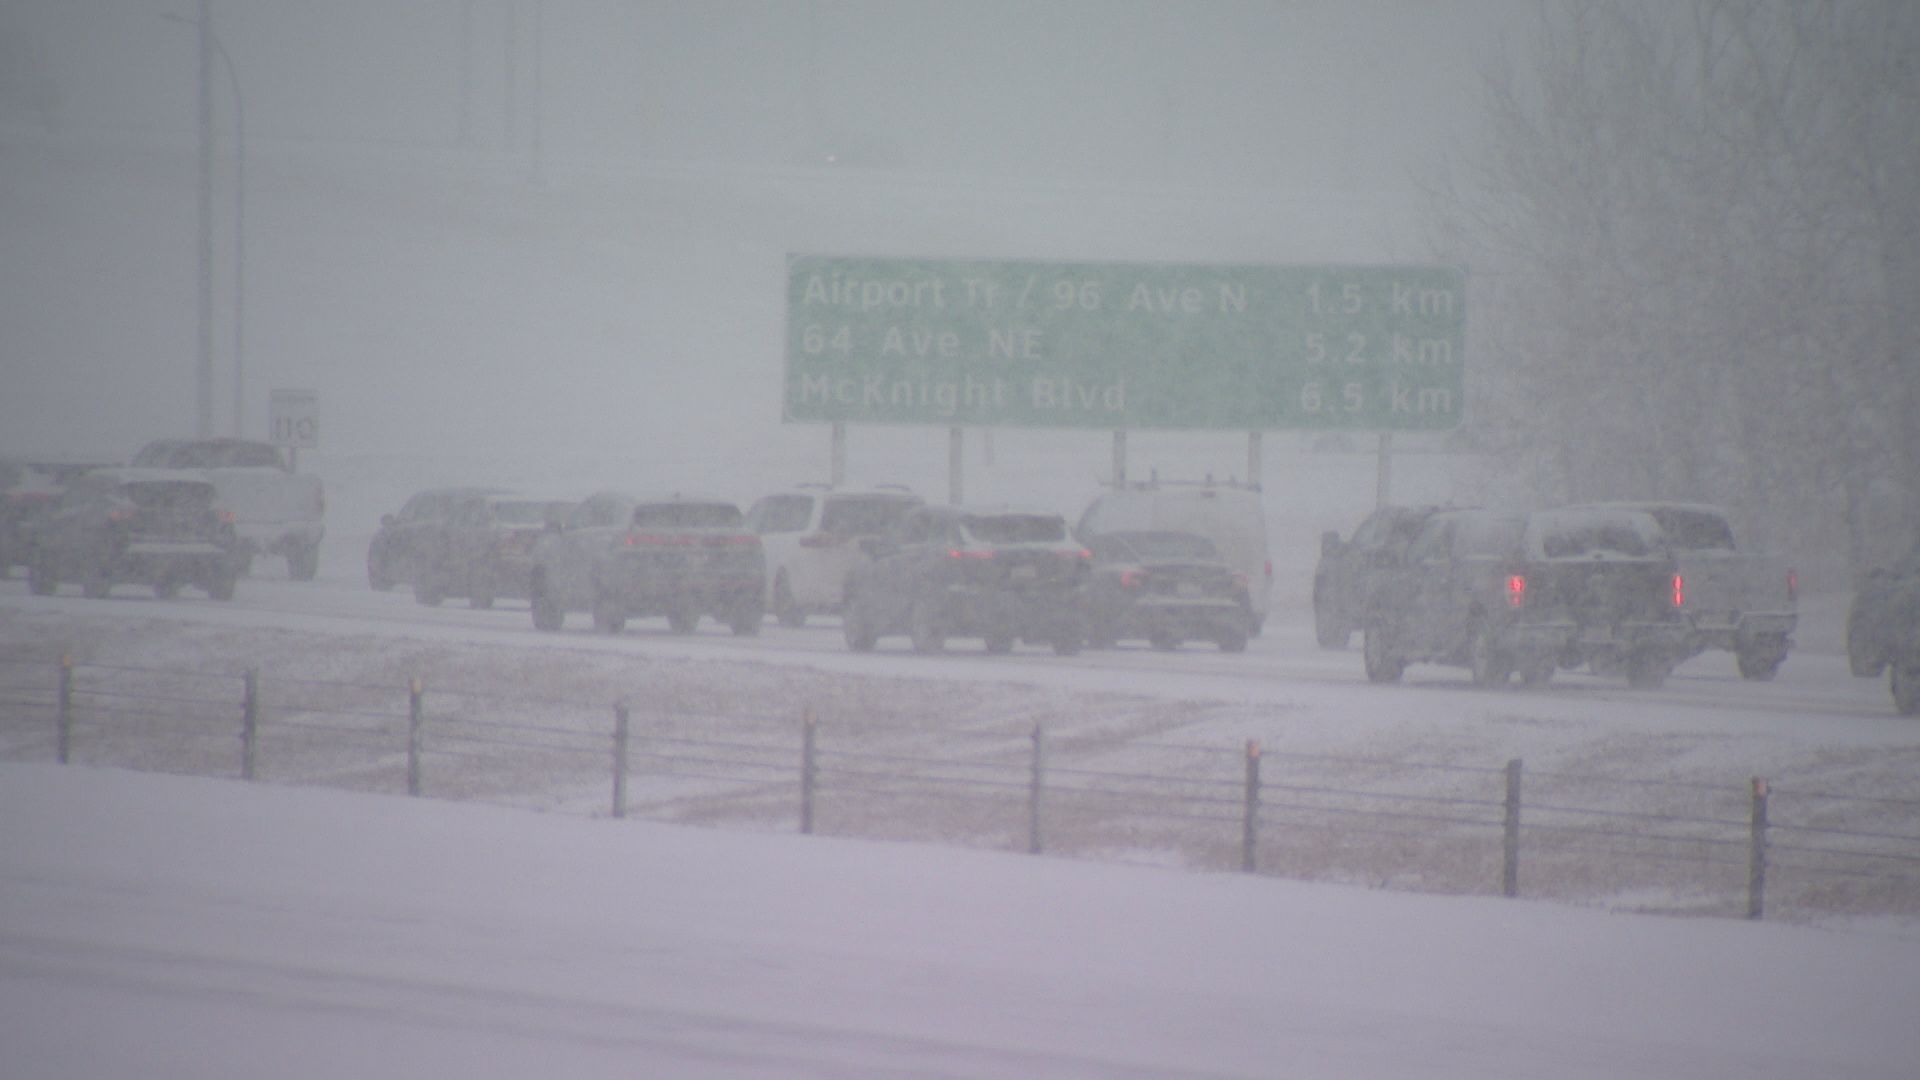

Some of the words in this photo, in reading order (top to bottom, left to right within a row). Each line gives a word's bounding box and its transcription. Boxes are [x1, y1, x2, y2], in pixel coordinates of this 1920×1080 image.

[802, 270, 945, 311] Airport
[961, 278, 1000, 308] Tr
[1015, 274, 1036, 308] /
[1053, 279, 1103, 310] 96
[1129, 281, 1203, 313] Ave
[1218, 282, 1249, 313] N
[1308, 281, 1362, 315] 1.5
[1391, 282, 1454, 315] km
[801, 323, 853, 355] 64
[882, 325, 961, 357] Ave
[989, 328, 1044, 359] NE
[1305, 332, 1367, 364] 5.2
[1391, 332, 1453, 365] km
[800, 372, 1008, 416] McKnight
[1031, 376, 1127, 412] Blvd
[1301, 381, 1364, 414] 6.5
[1391, 381, 1453, 414] km
